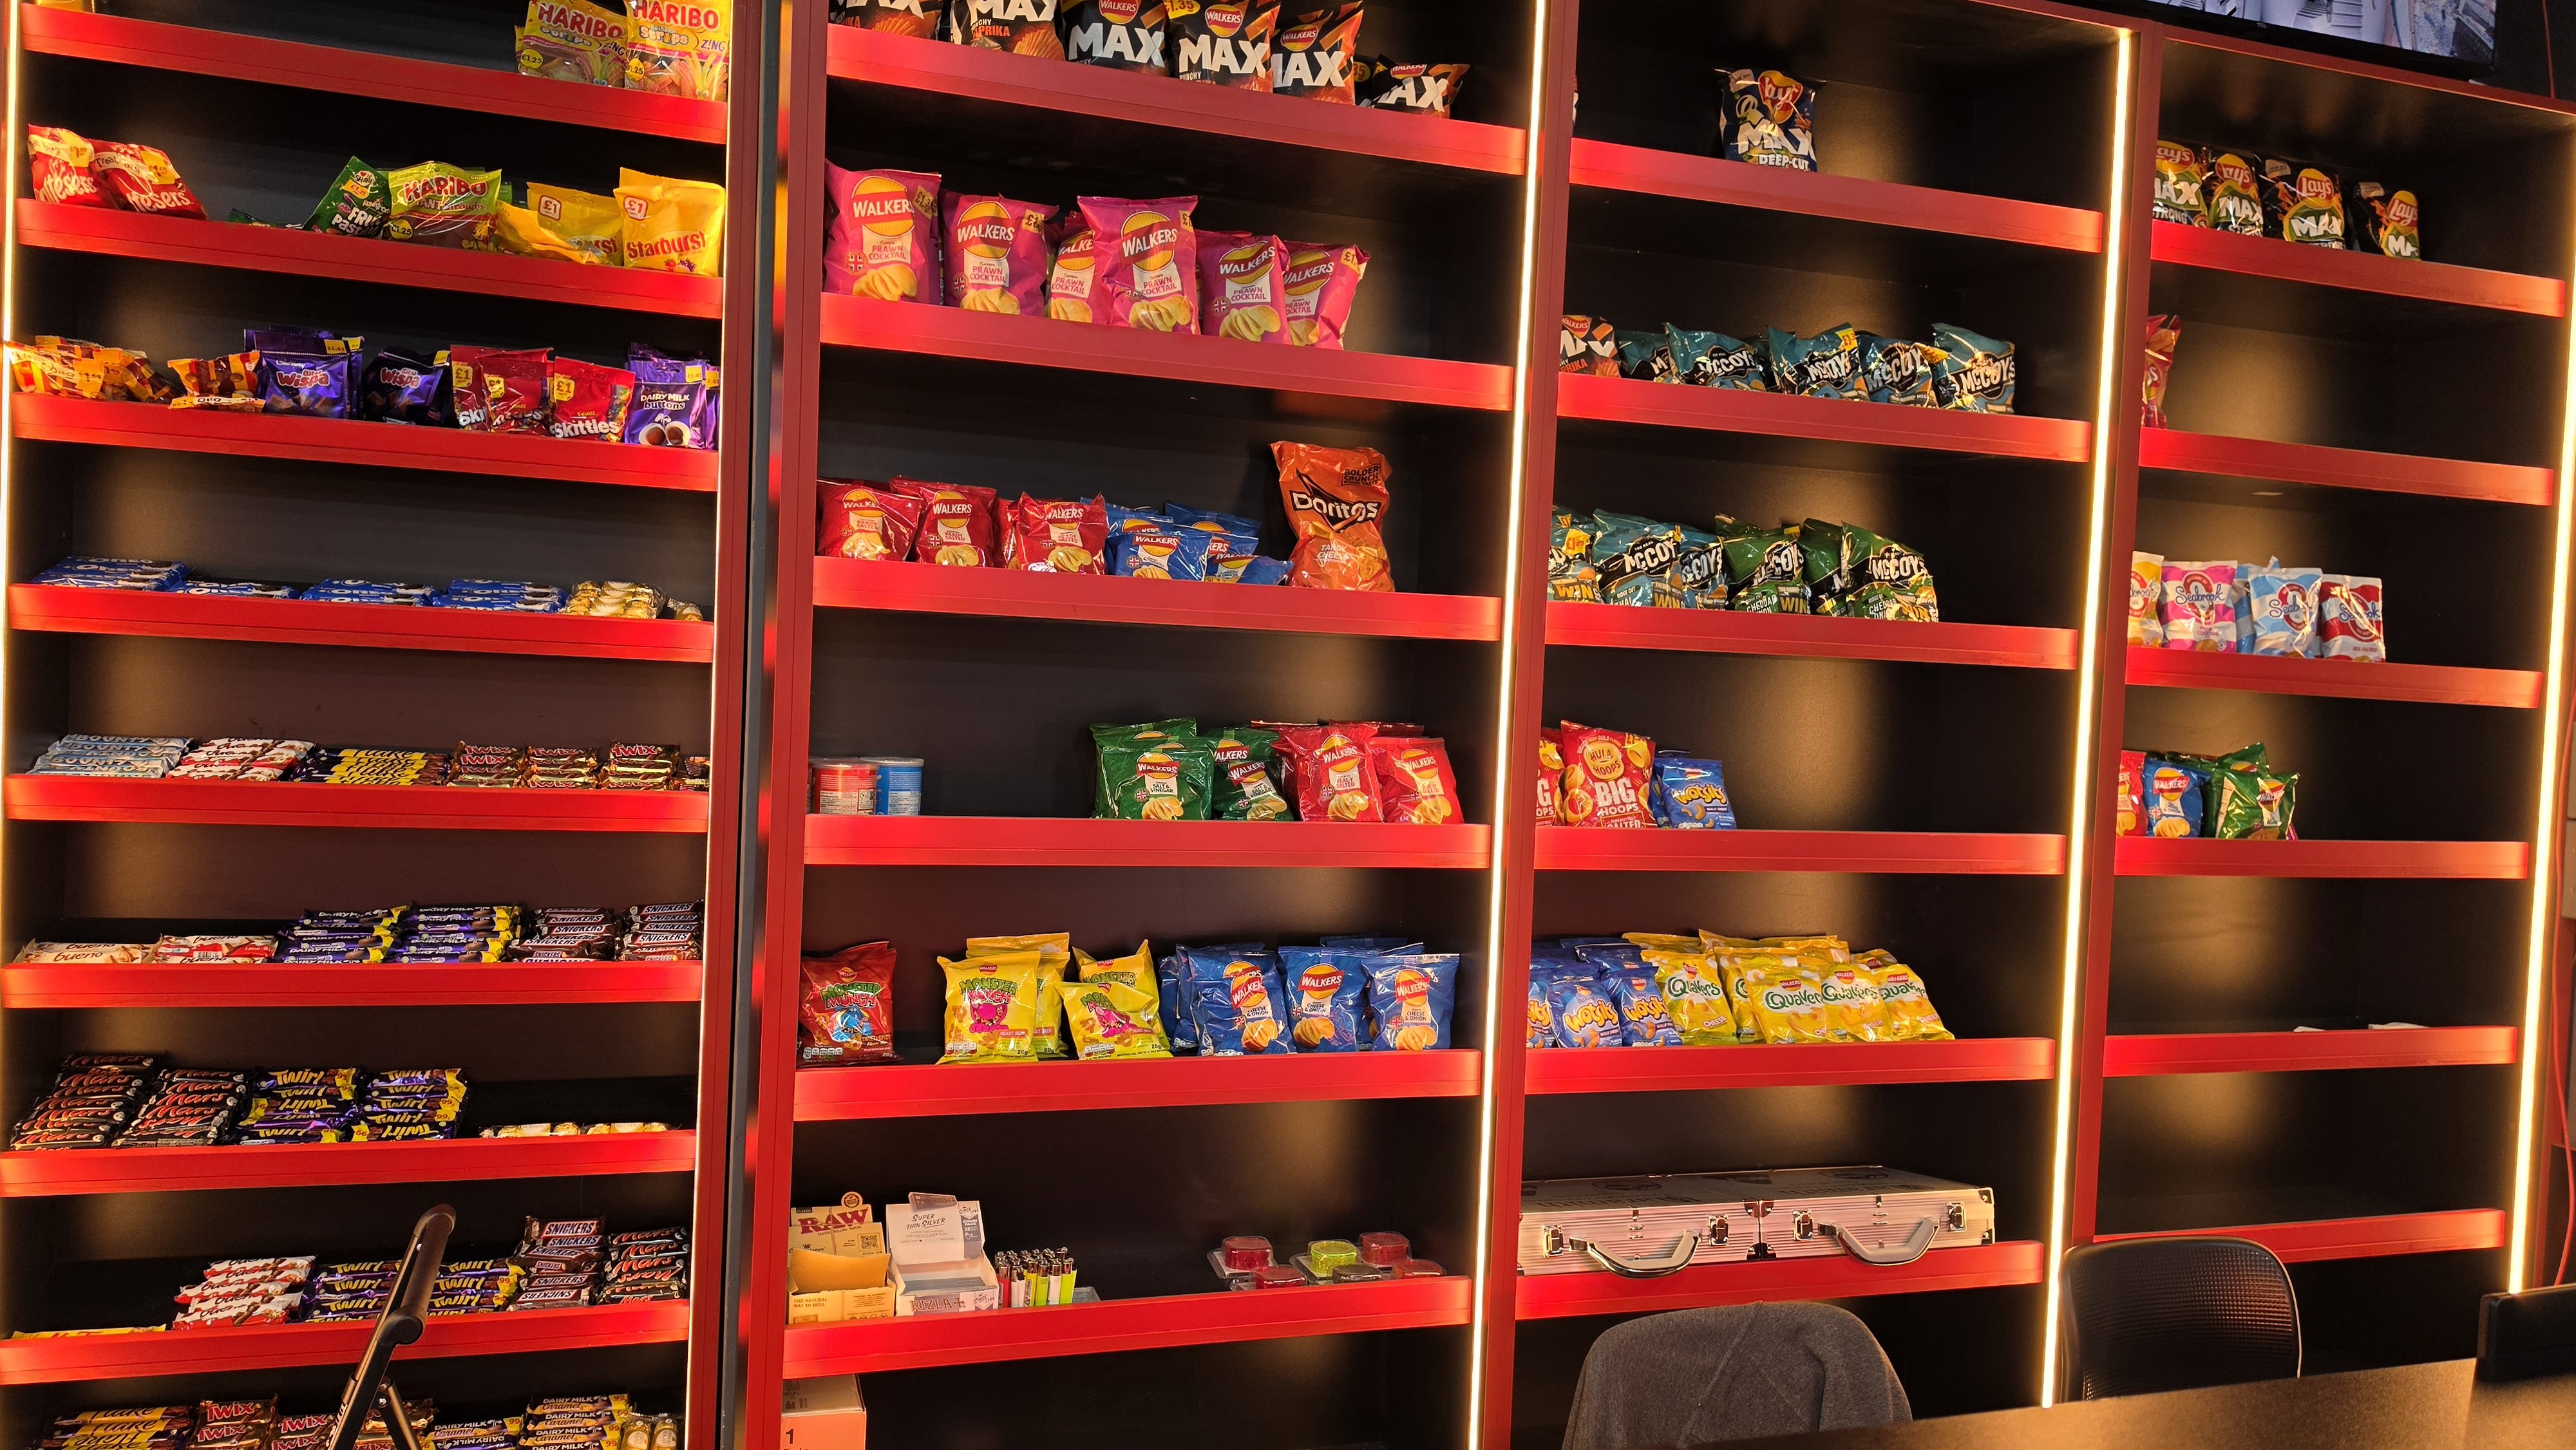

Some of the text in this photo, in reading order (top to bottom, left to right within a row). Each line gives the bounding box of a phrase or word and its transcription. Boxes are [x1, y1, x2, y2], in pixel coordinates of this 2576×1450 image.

[970, 0, 1056, 22] MAX
[1100, 1, 1137, 12] WALKERS
[538, 3, 623, 38] HARIBO
[633, 0, 719, 28] HARIBO
[1206, 11, 1241, 26] WALKERS
[1281, 30, 1317, 42] WALKERS
[1068, 23, 1164, 68] MAX
[521, 53, 542, 64] £1.25
[1179, 34, 1271, 79] MAX
[626, 63, 643, 74] £1.25
[96, 155, 118, 168] Treat
[1758, 154, 1810, 171] DEEP-CUT
[402, 176, 488, 202] HARIBO
[543, 200, 558, 215] £1
[627, 200, 643, 214] £1
[853, 198, 914, 218] WALKERS
[2219, 195, 2263, 224] MAX
[391, 225, 411, 236] £1.25
[957, 223, 1015, 243] WALKERS
[625, 231, 706, 259] Starburst
[1122, 228, 1178, 258] WALKERS
[869, 252, 906, 260] COCKTAIL
[1220, 246, 1275, 274] WALKERS
[972, 266, 1003, 275] PRAWN
[970, 273, 1006, 283] COCKTAIL
[1143, 276, 1173, 288] PRAWN
[1142, 281, 1177, 296] COCKTAIL
[1233, 287, 1263, 295] PRAWN
[1231, 292, 1266, 301] COCKTAIL
[1562, 317, 1588, 329] WALKERS
[277, 370, 330, 388] Wispa
[381, 368, 420, 388] Wispa
[455, 371, 469, 379] £1
[556, 381, 571, 392] £1
[641, 393, 690, 402] DAIRY MILK
[643, 400, 685, 410] buttons
[554, 420, 620, 438] Skittles
[1344, 464, 1379, 476] BOLDER
[1343, 473, 1379, 483] CRUNCH
[933, 503, 972, 514] WALKERS
[1292, 492, 1381, 519] Doritos
[1135, 535, 1179, 546] WALKERS
[2175, 583, 2225, 605] Seabrook
[614, 744, 657, 757] Twix
[1323, 746, 1357, 764] WALKERS
[1590, 749, 1612, 761] HULA
[461, 755, 506, 764] Twix
[1137, 762, 1177, 773] WALKERS
[1231, 761, 1265, 780] WALKERS
[1593, 760, 1620, 775] HOOPS
[1595, 777, 1636, 807] BIG
[1672, 784, 1728, 805] Wotsits
[1598, 804, 1639, 817] HOOPS
[644, 904, 692, 913] SNICKERS
[640, 933, 688, 942] SNICKERS
[53, 952, 103, 963] bueno
[960, 977, 1019, 994] MONSTER
[1302, 975, 1342, 987] WALKERS
[1667, 976, 1721, 997] Quavers
[820, 981, 883, 1001] MONSTER
[1232, 981, 1264, 1003] WALKER
[1397, 981, 1428, 997] WALKERS
[826, 993, 876, 1010] MUNCH
[966, 990, 1012, 1004] MUNCH
[1564, 1001, 1618, 1032] Wotsits
[1703, 1015, 1727, 1028] CHEESE
[61, 1075, 129, 1087] Mars
[269, 1069, 325, 1085] Twirl
[166, 1083, 234, 1093] Mars
[380, 1098, 428, 1109] Twirl
[545, 1222, 596, 1235] SNICKERS
[798, 1209, 868, 1234] RAW
[922, 1218, 945, 1227] SILVER
[550, 1236, 599, 1247] SNICKERS
[536, 1261, 560, 1270] SNICKERS
[612, 1257, 675, 1273] Mars
[436, 1277, 482, 1290] Twirl
[207, 1402, 256, 1420] Twix
[279, 1415, 327, 1433] Twix
[786, 1429, 793, 1444] 1
